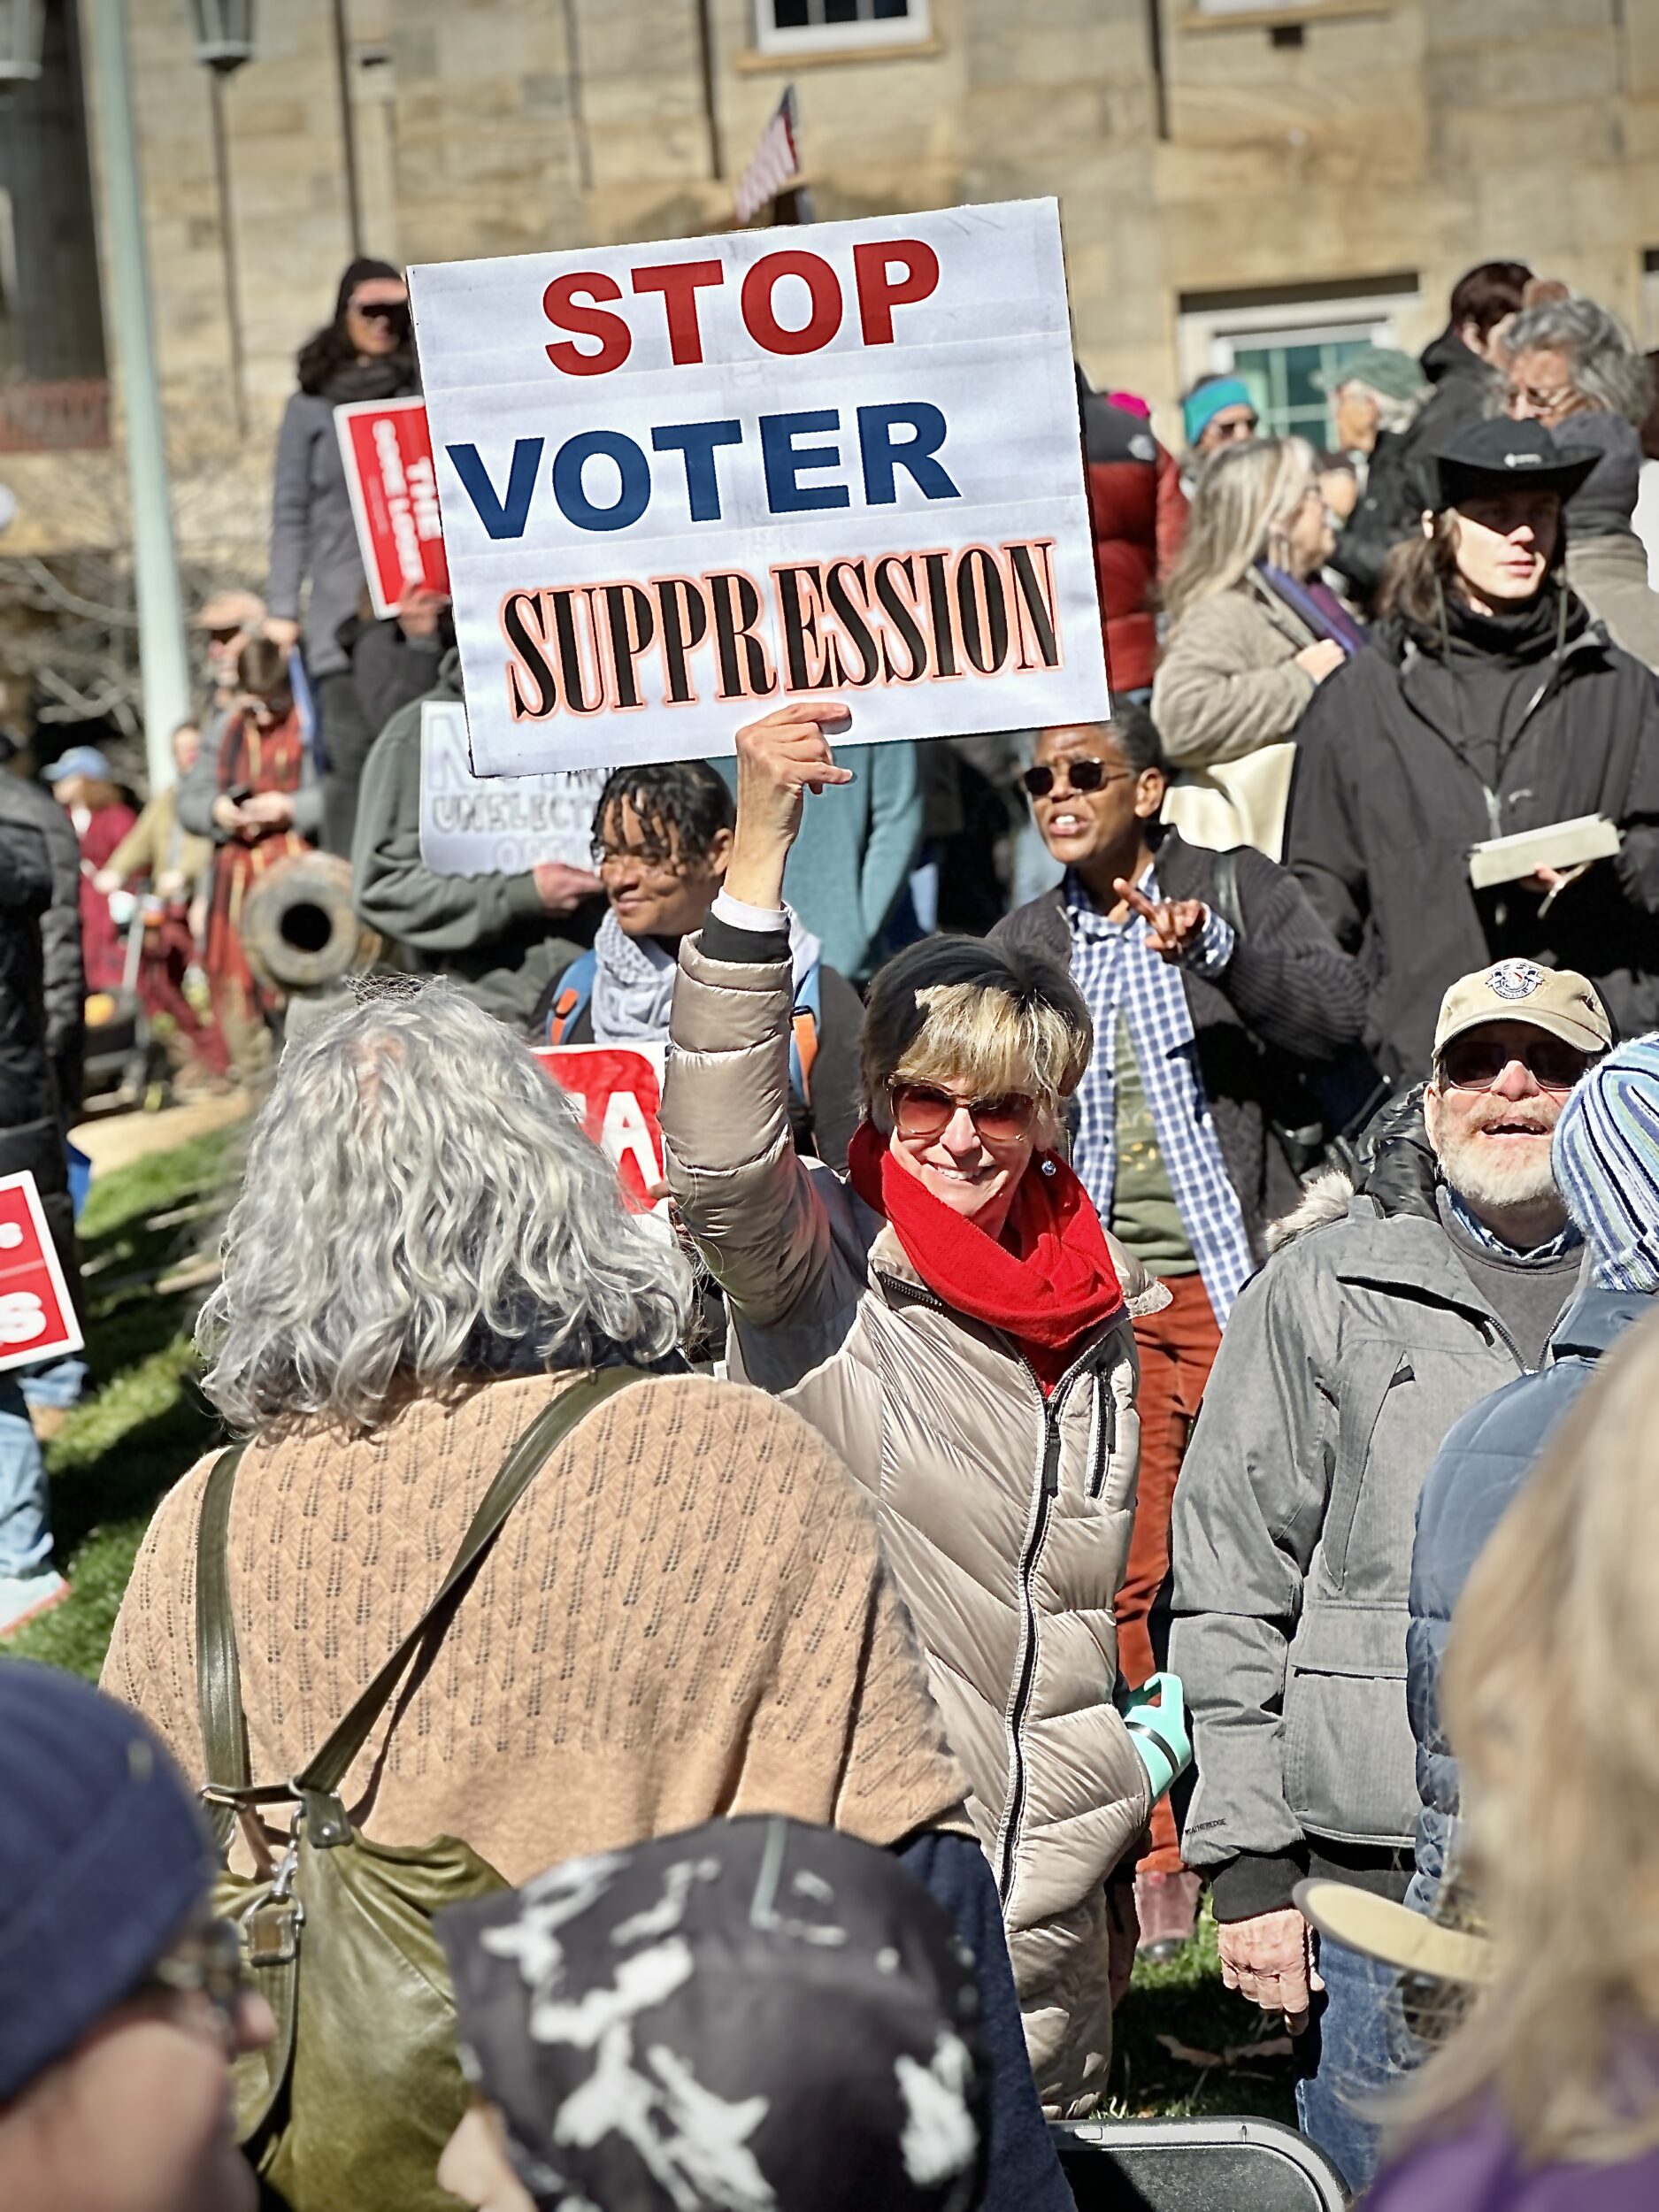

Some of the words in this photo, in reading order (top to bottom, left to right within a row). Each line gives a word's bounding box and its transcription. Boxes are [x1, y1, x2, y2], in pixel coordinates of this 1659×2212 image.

[542, 239, 940, 376] STOP
[445, 402, 962, 540] VOTER
[502, 541, 1062, 720] SUPPRESSION
